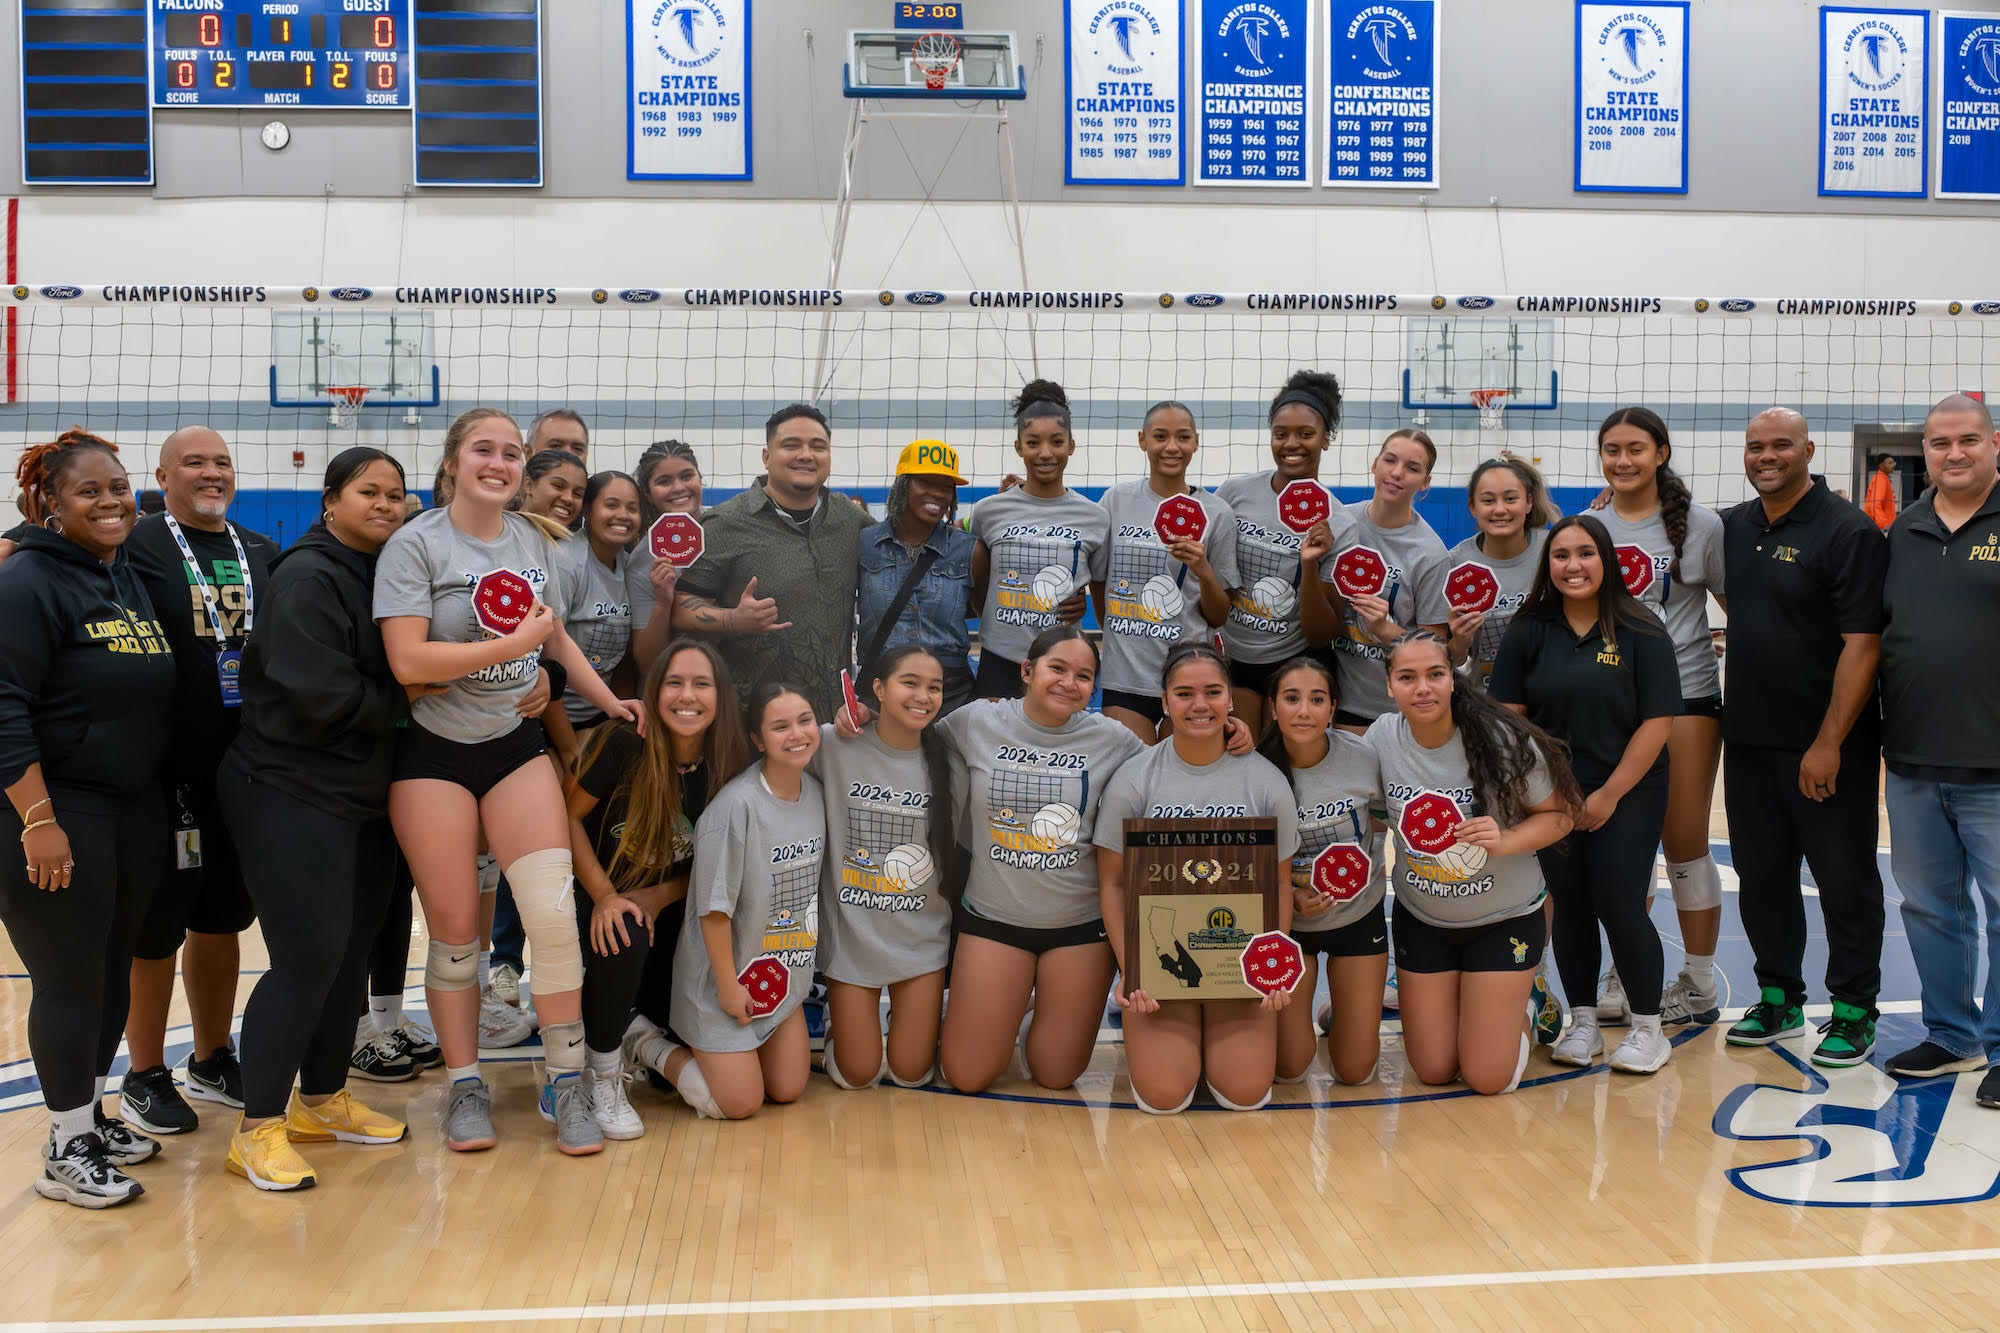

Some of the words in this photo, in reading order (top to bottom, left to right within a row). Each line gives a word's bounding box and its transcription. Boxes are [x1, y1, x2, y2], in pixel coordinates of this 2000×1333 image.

[158, 0, 224, 10] FALCONS
[262, 4, 299, 15] PERIOD
[343, 0, 391, 11] GUEST
[903, 5, 957, 18] 32.00
[1089, 1, 1126, 34] CERRITOS
[1129, 2, 1161, 35] COLLEGE
[1219, 3, 1257, 37] CERRITOS
[1258, 4, 1290, 39] COLLEGE
[1347, 5, 1385, 40] CERRITOS
[1386, 6, 1417, 41] COLLEGE
[200, 14, 219, 46] 0
[283, 20, 289, 42] 1
[374, 16, 393, 47] 0
[1598, 13, 1634, 45] CERRITOS
[1636, 13, 1666, 47] COLLEGE
[1843, 20, 1877, 52] CERRITOS
[1879, 21, 1908, 55] COLLEGE
[1959, 25, 1993, 56] CERRITOS
[164, 50, 197, 61] FOULS
[208, 51, 236, 61] T.O.L.
[247, 50, 285, 61] PLAYER
[290, 51, 316, 61] FOUL
[325, 51, 353, 61] T.O.L.
[365, 51, 397, 62] FOULS
[678, 47, 721, 68] BASKETBALL
[178, 62, 193, 87] 0
[215, 62, 231, 87] 2
[305, 64, 311, 86] 1
[332, 63, 348, 88] 2
[378, 63, 393, 88] 0
[1107, 64, 1144, 75] BASEBALL
[1235, 64, 1274, 78] BASEBALL
[1362, 67, 1402, 80] BASEBALL
[1608, 68, 1628, 84] MEN'S
[1630, 69, 1656, 85] SOCCER
[660, 75, 718, 89] STATE
[1848, 71, 1876, 91] WOMEN'S
[1878, 72, 1902, 91] SOCCER
[1964, 74, 1992, 95] WOMEN'S
[1098, 82, 1153, 96] STATE
[1205, 83, 1303, 98] CONFERENCE
[1334, 85, 1431, 100] CONFERENCE
[166, 92, 199, 104] SCORE
[264, 92, 300, 104] MATCH
[365, 94, 398, 104] SCORE
[638, 92, 740, 106] CHAMPIONS
[1076, 98, 1175, 113] CHAMPIONS
[1607, 91, 1658, 105] STATE
[1850, 98, 1900, 112] STATE
[1204, 99, 1304, 115] CHAMPIONS
[1333, 101, 1431, 117] CHAMPIONS
[1586, 107, 1679, 122] CHAMPIONS
[642, 111, 667, 121] 1968
[677, 111, 702, 122] 1983
[712, 112, 737, 122] 1989
[1080, 117, 1103, 127] 1966
[1114, 117, 1137, 128] 1970
[1148, 118, 1171, 128] 1973
[1831, 113, 1920, 129] CHAMPIONS
[642, 127, 667, 137] 1992
[677, 127, 702, 137] 1999
[1208, 118, 1233, 130] 1959
[1242, 119, 1265, 130] 1961
[1275, 120, 1300, 131] 1962
[1336, 120, 1361, 131] 1976
[1369, 121, 1394, 132] 1977
[1402, 121, 1427, 132] 1978
[1588, 126, 1613, 136] 2006
[1620, 126, 1645, 136] 2008
[1653, 127, 1676, 136] 2014
[1080, 132, 1103, 143] 1974
[1114, 133, 1137, 143] 1975
[1148, 133, 1172, 143] 1979
[1208, 134, 1233, 145] 1965
[1241, 134, 1266, 146] 1966
[1275, 135, 1300, 147] 1967
[1336, 135, 1361, 146] 1979
[1369, 136, 1394, 147] 1985
[1402, 137, 1427, 148] 1987
[1833, 131, 1856, 141] 2007
[1862, 132, 1887, 142] 2008
[1895, 133, 1916, 143] 2012
[1948, 134, 1971, 145] 2018
[1589, 140, 1612, 150] 2018
[1834, 146, 1855, 156] 2013
[1863, 147, 1884, 157] 2014
[1894, 148, 1916, 157] 2015
[1080, 148, 1104, 158] 1985
[1114, 148, 1137, 158] 1987
[1148, 148, 1172, 158] 1989
[1208, 149, 1233, 160] 1969
[1241, 149, 1266, 161] 1970
[1275, 150, 1300, 161] 1972
[1336, 150, 1361, 161] 1988
[1369, 151, 1394, 162] 1989
[1402, 152, 1427, 163] 1990
[1208, 164, 1233, 175] 1973
[1241, 165, 1266, 176] 1974
[1275, 165, 1300, 176] 1975
[1336, 165, 1359, 177] 1991
[1369, 166, 1394, 177] 1992
[1402, 167, 1427, 178] 1995
[1833, 161, 1854, 171] 2016
[46, 287, 76, 298] Ford
[102, 285, 266, 302] CHAMPIONSHIPS
[335, 287, 365, 299] Ford
[395, 287, 557, 304] CHAMPIONSHIPS
[624, 290, 655, 301] Ford
[684, 289, 843, 306] CHAMPIONSHIPS
[911, 293, 940, 304] Ford
[969, 291, 1124, 308] CHAMPIONSHIPS
[1190, 294, 1219, 305] Ford
[1247, 293, 1398, 310] CHAMPIONSHIPS
[1461, 297, 1490, 307] Ford
[1516, 296, 1661, 313] CHAMPIONSHIPS
[1723, 300, 1751, 311] Ford
[1776, 299, 1916, 316] CHAMPIONSHIPS
[918, 445, 957, 470] POLY
[1288, 512, 1322, 525] CHAMPIONS
[1002, 525, 1080, 541] 2024-2025
[500, 579, 523, 592] CIF-SS
[483, 588, 493, 597] 20
[518, 604, 529, 613] 24
[482, 602, 521, 625] CHAMPIONS
[1596, 652, 1621, 667] POLY
[997, 745, 1087, 769] 2024-2025
[1152, 805, 1246, 818] 2024-2025
[1411, 801, 1432, 817] CIF-SS
[1410, 829, 1420, 837] 20
[1441, 809, 1451, 818] 24
[1147, 832, 1257, 845] CHAMPIONS
[1420, 822, 1455, 846] CHAMPIONS
[989, 844, 1080, 871] CHAMPIONS
[1149, 863, 1178, 882] 20
[1227, 862, 1256, 880] 24
[1405, 869, 1494, 897] CHAMPIONS
[838, 886, 928, 912] CHAMPIONS
[1210, 910, 1233, 929] CIF
[1257, 942, 1280, 953] CIF-SS
[1251, 963, 1259, 971] 20
[1285, 955, 1294, 963] 24
[1256, 969, 1294, 986] CHAMPIONS
